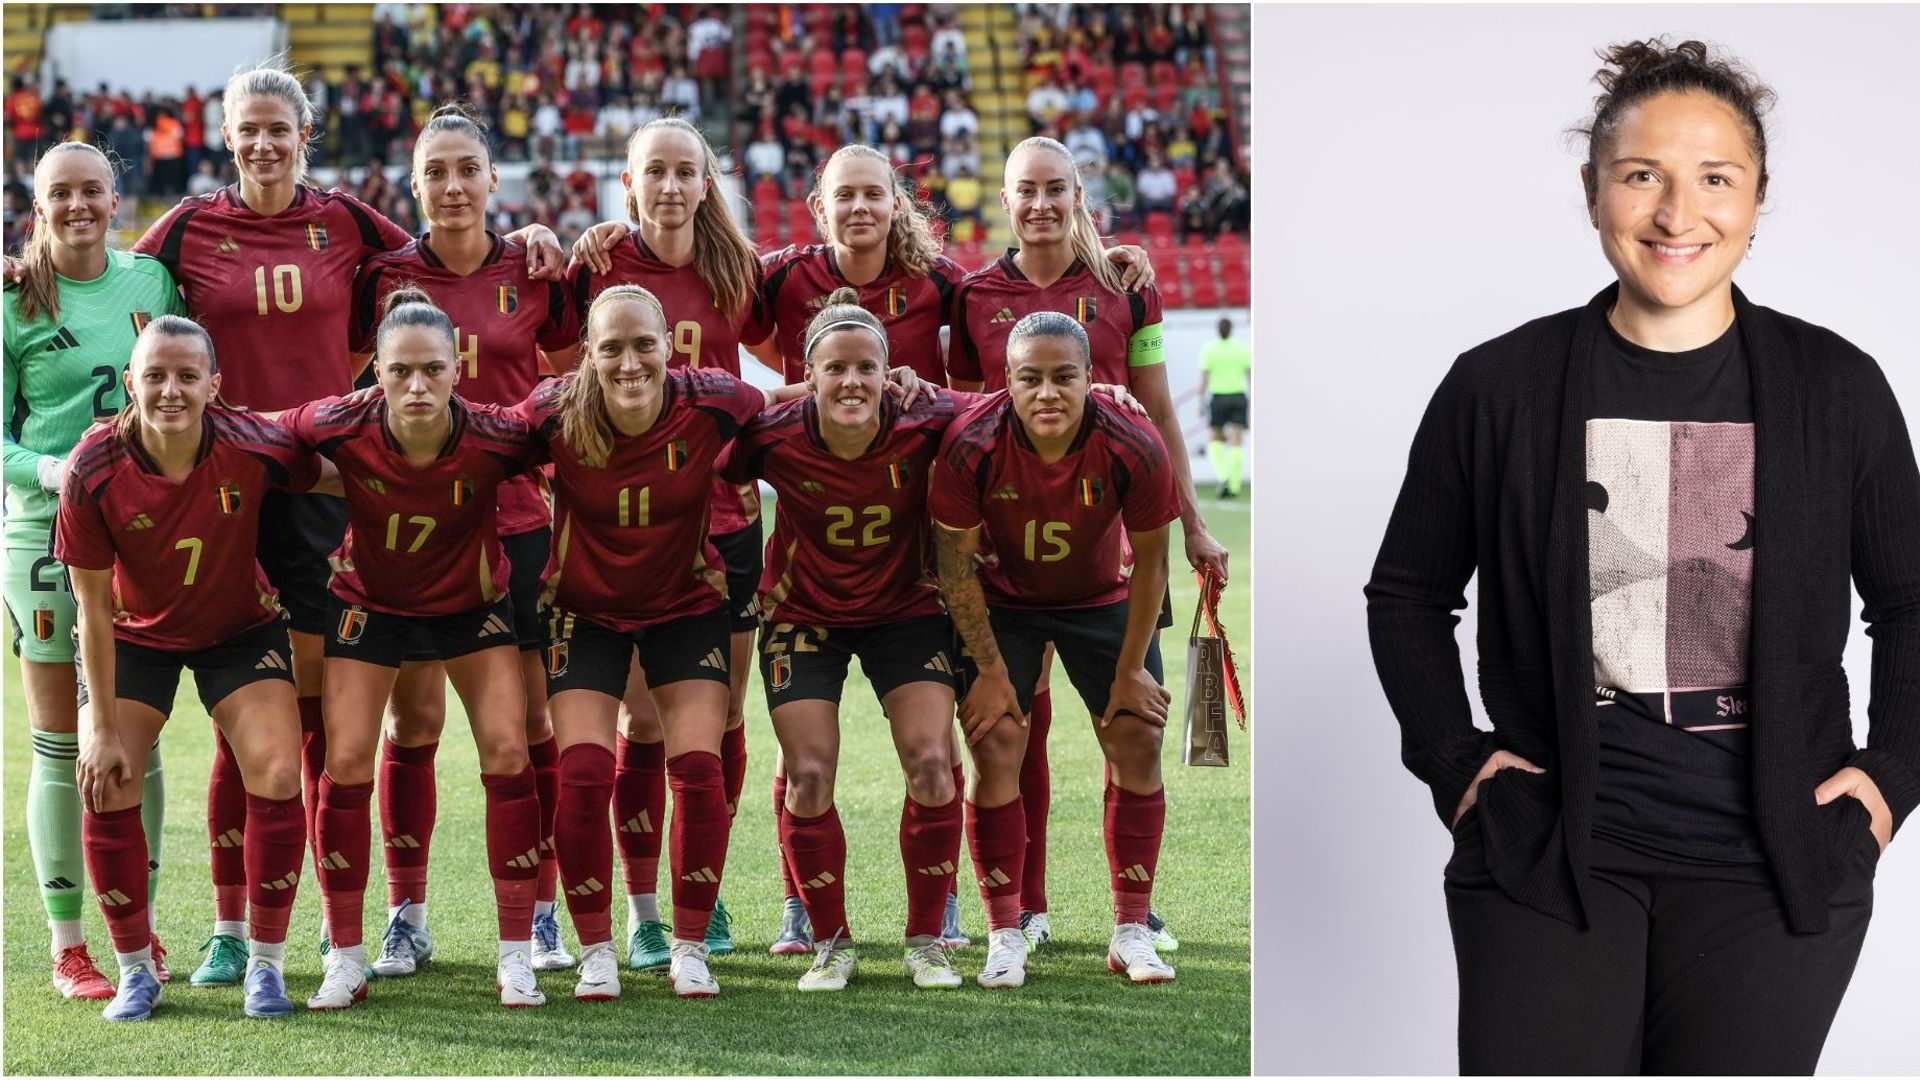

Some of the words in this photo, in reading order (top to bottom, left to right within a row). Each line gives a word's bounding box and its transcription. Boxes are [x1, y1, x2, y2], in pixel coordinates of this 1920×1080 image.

[255, 264, 302, 315] 10
[619, 486, 649, 527] 11
[825, 505, 891, 547] 22
[386, 513, 437, 553] 17
[1024, 519, 1071, 562] 15
[175, 537, 203, 586] 7
